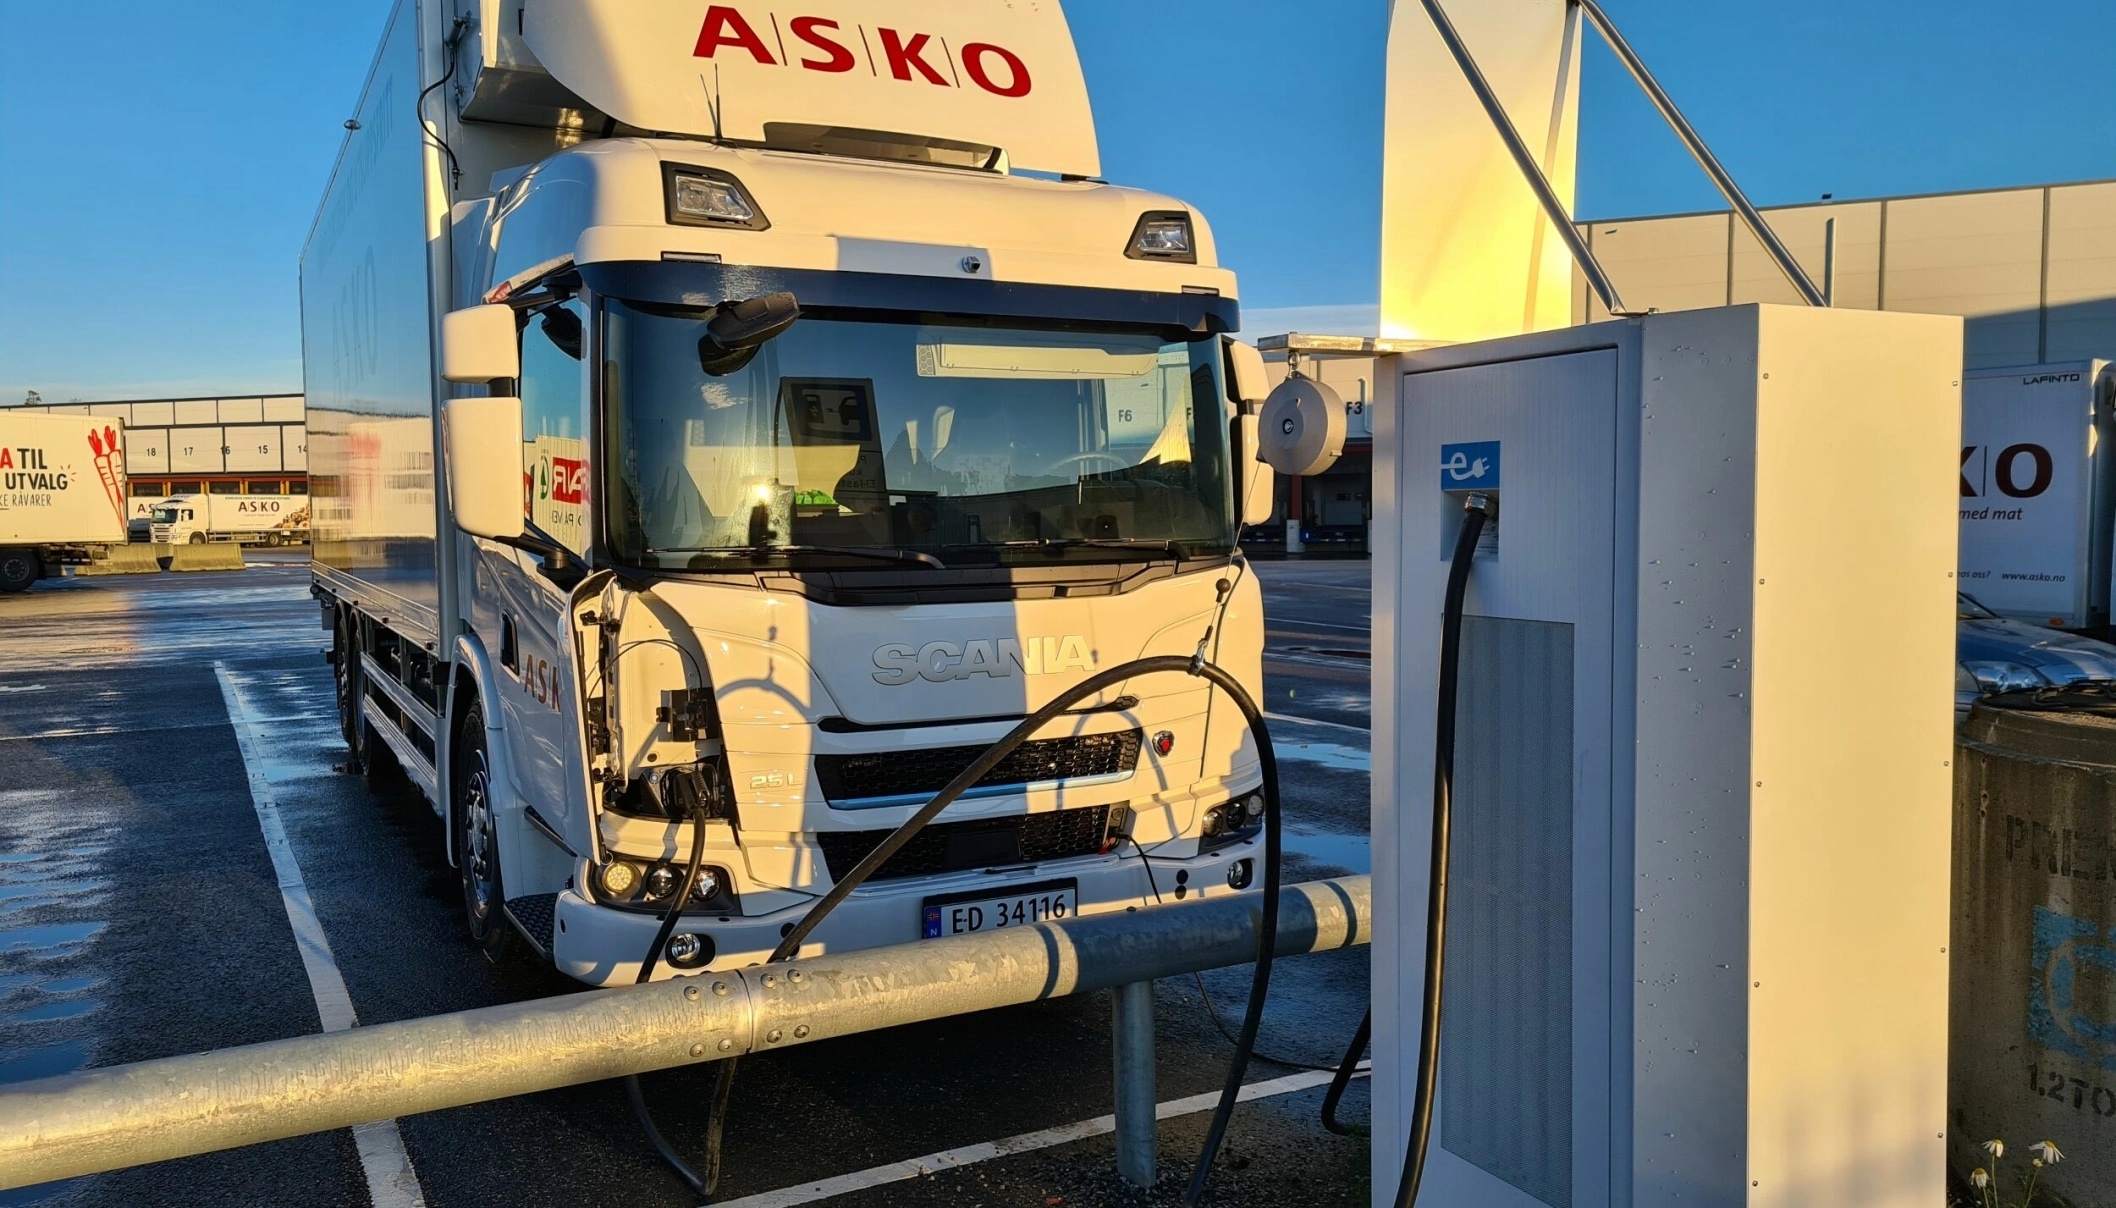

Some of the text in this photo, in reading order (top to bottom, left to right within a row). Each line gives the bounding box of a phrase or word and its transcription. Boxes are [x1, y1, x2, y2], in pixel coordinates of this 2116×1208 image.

[1346, 401, 1363, 415] F3
[1118, 409, 1133, 422] F6
[146, 447, 157, 457] 18
[183, 446, 194, 456] 17
[257, 444, 269, 454] 15
[17, 448, 48, 470] TIL
[5, 472, 69, 490] UTVALG
[1992, 508, 2023, 520] mat
[2001, 571, 2066, 582] www.asko.no
[872, 635, 1096, 686] SCANIA
[952, 894, 1066, 934] ED 34116
